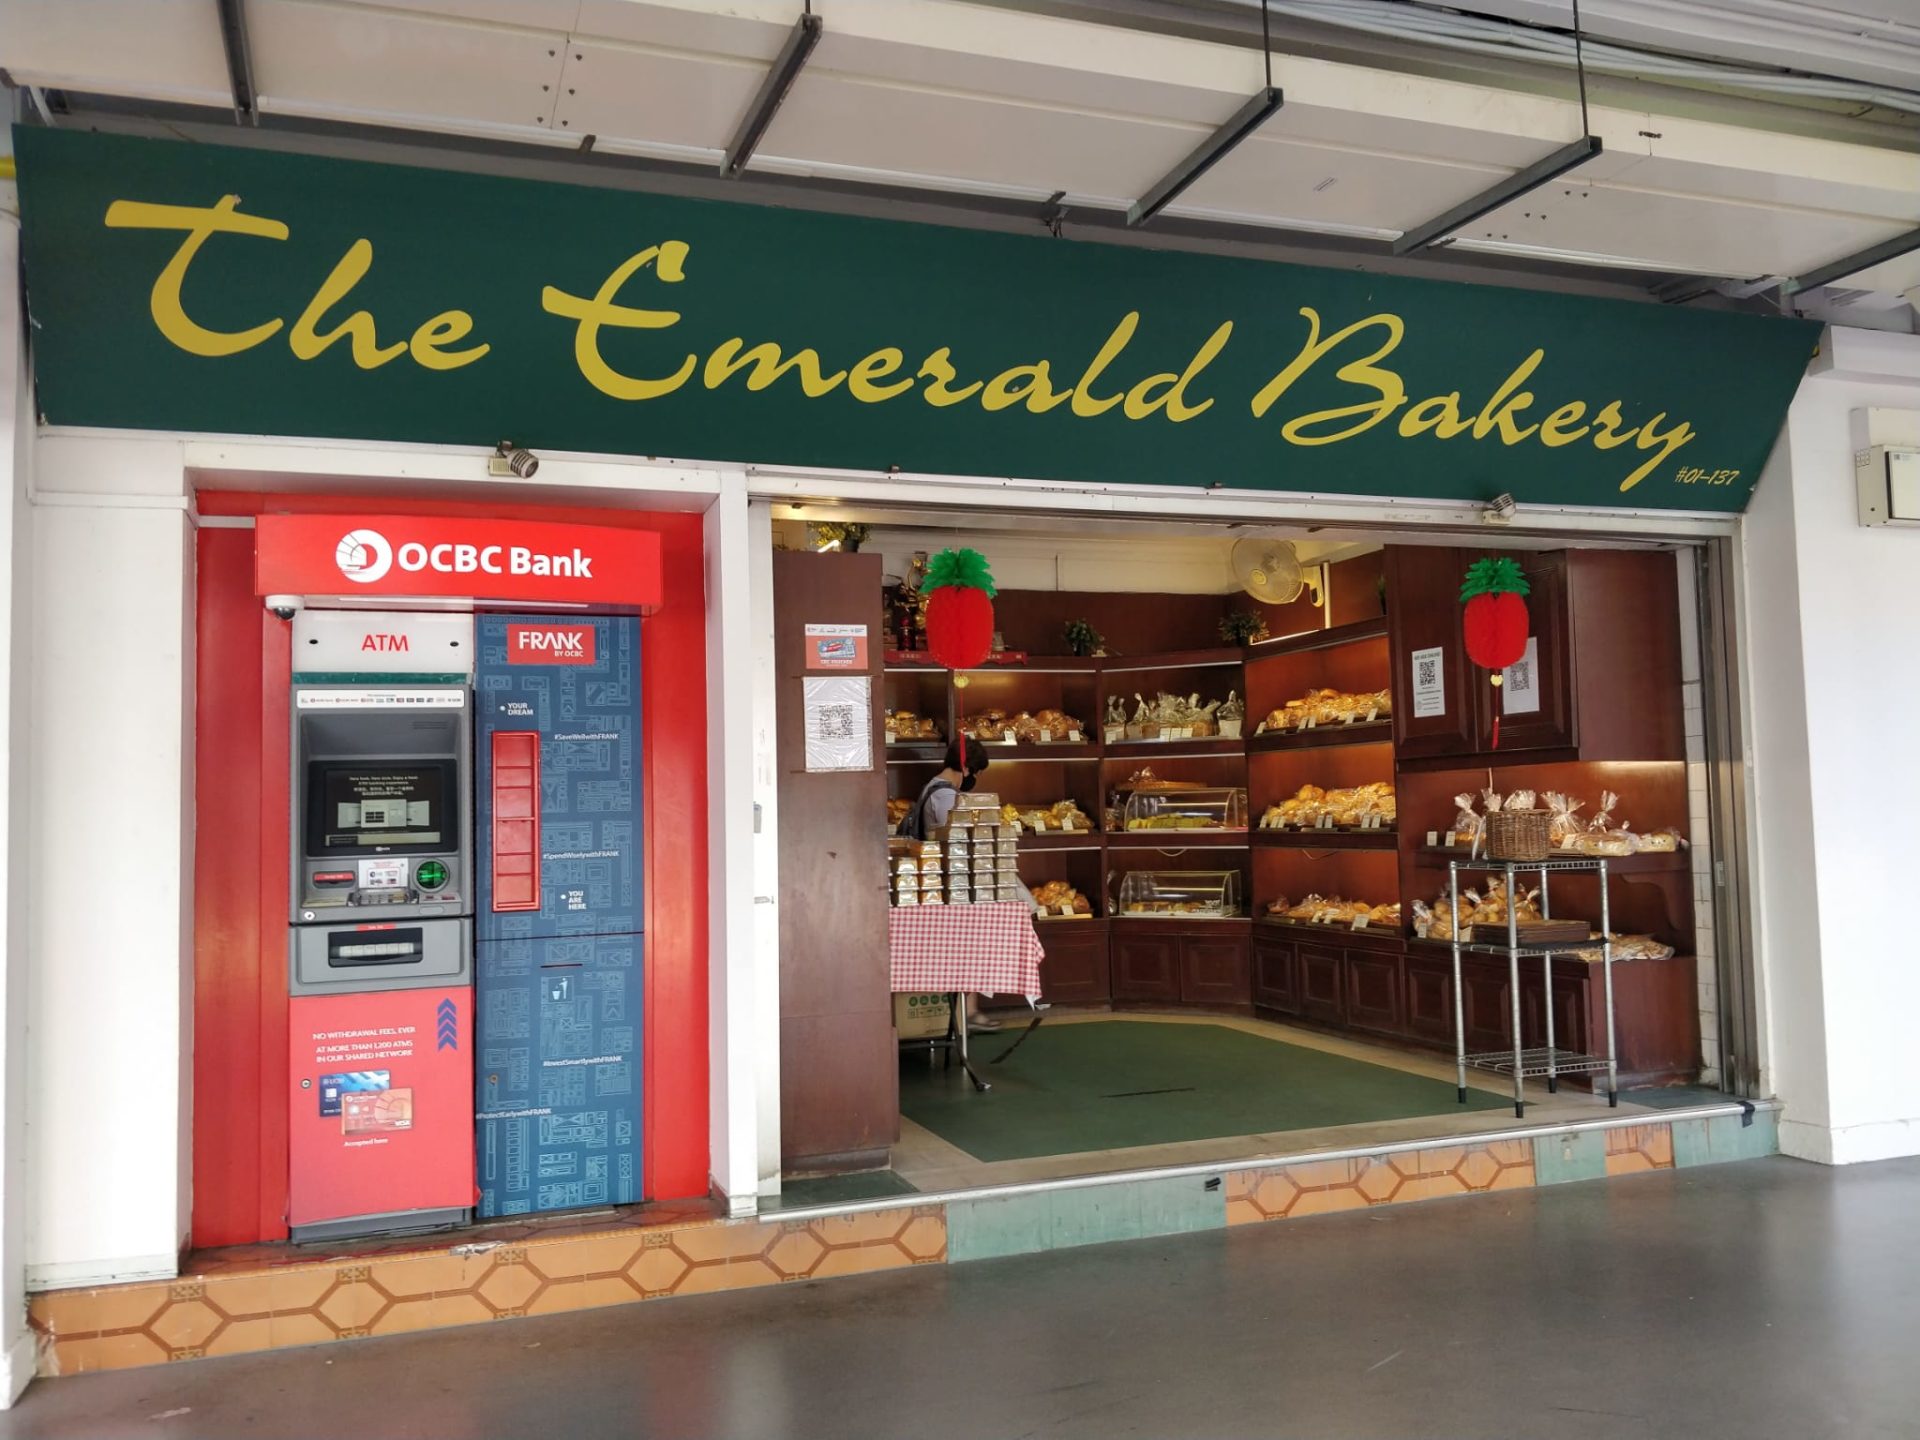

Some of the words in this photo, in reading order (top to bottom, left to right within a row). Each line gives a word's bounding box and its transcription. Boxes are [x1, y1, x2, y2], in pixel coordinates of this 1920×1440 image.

[105, 194, 490, 370] The
[542, 240, 1233, 422] Emerald
[1251, 307, 1695, 491] Bakery
[1675, 466, 1740, 486] #01-137
[398, 542, 502, 574] OCBC
[510, 548, 592, 578] Bank
[362, 634, 409, 652] ATM
[519, 631, 583, 650] FRANK
[327, 1029, 378, 1039] WITHDRAWAL
[398, 1026, 416, 1034] EVER
[327, 1044, 350, 1052] MORE
[345, 1052, 374, 1060] SHARED
[375, 1049, 413, 1058] NETWORK
